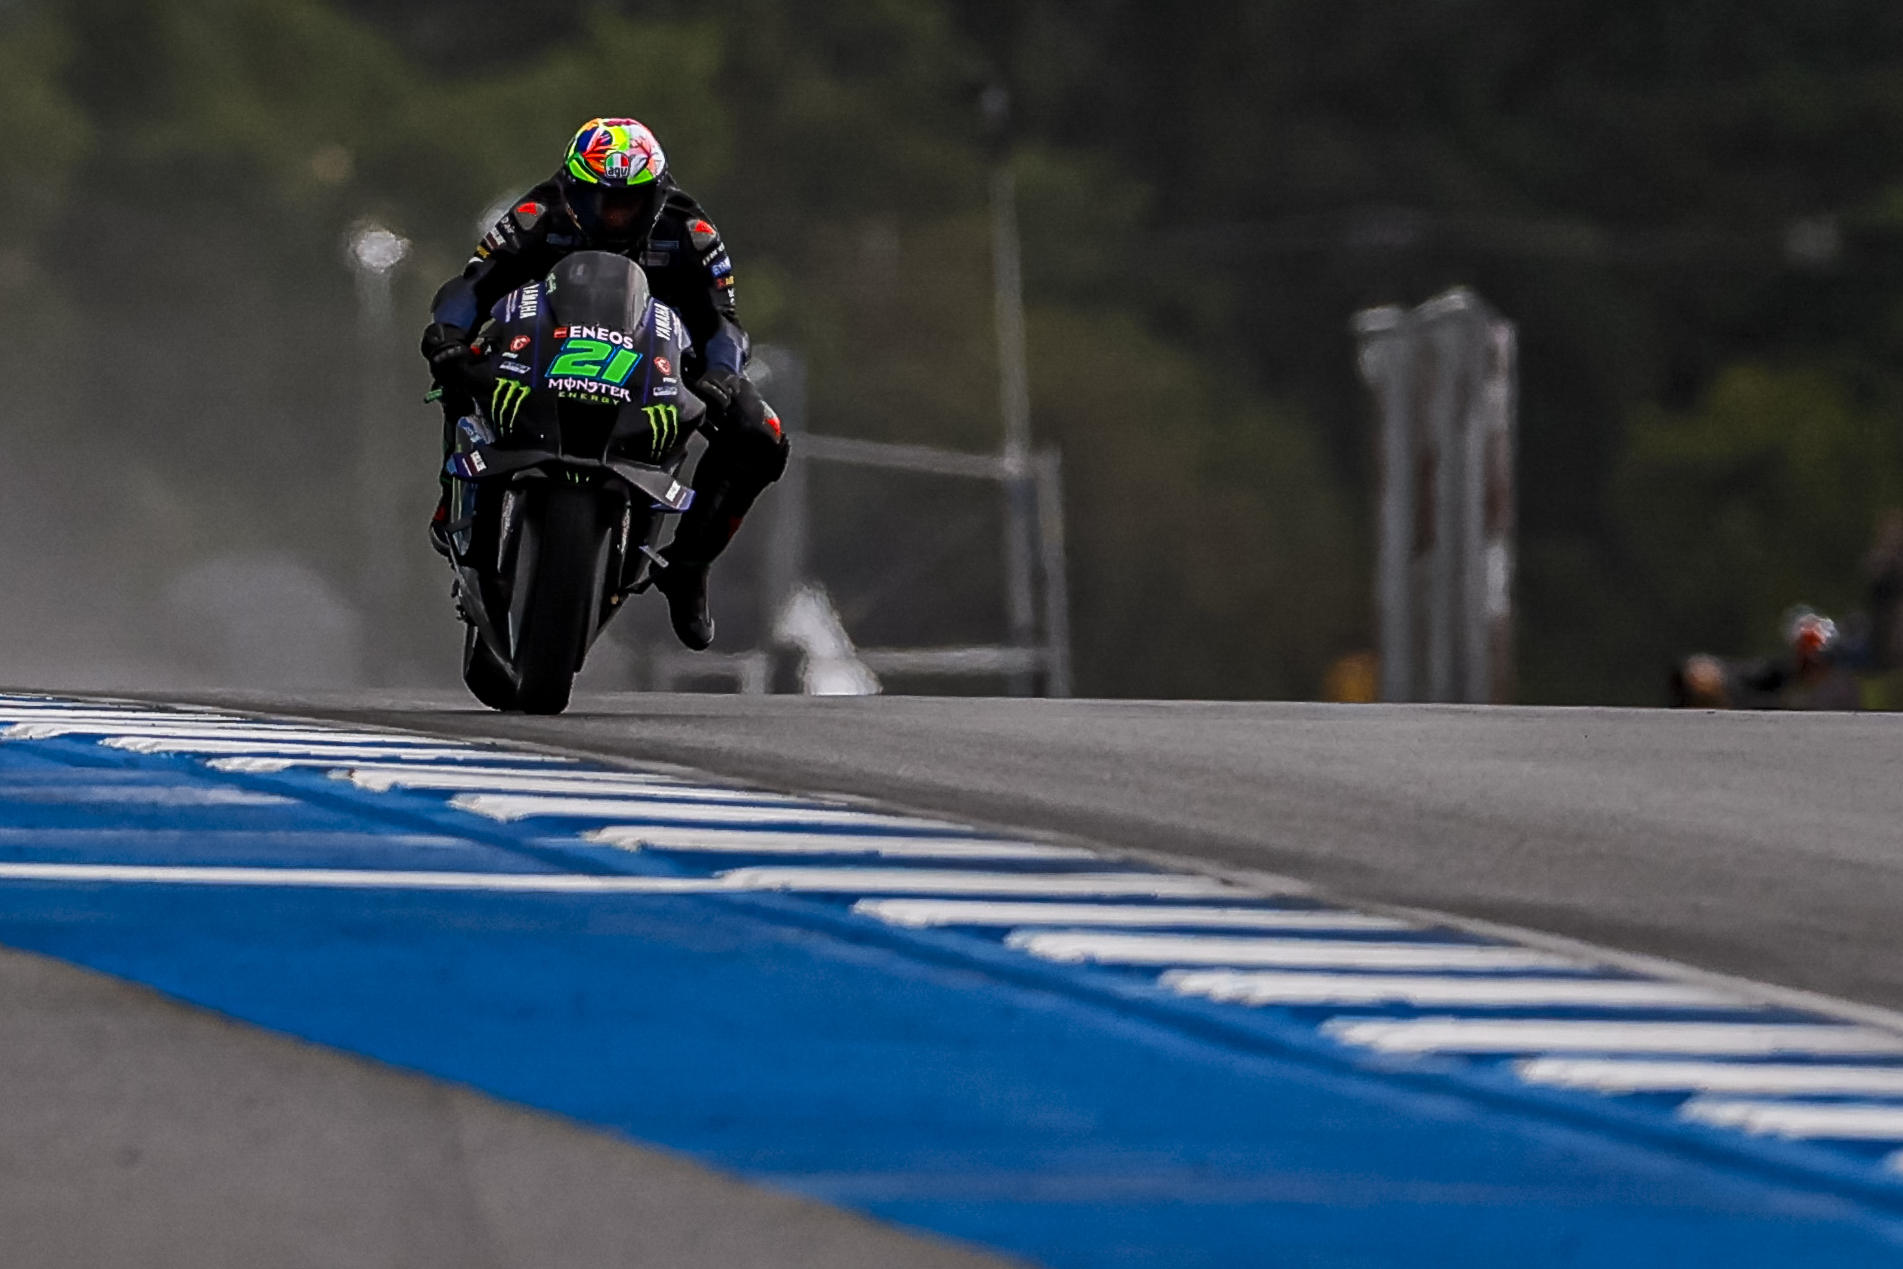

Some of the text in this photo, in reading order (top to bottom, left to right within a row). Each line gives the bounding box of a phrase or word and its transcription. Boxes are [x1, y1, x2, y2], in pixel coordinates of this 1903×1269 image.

[608, 166, 627, 177] agv
[569, 325, 634, 349] ENEOS
[549, 338, 640, 384] 21
[548, 377, 632, 402] MONSTER
[558, 391, 620, 405] ENERGY
